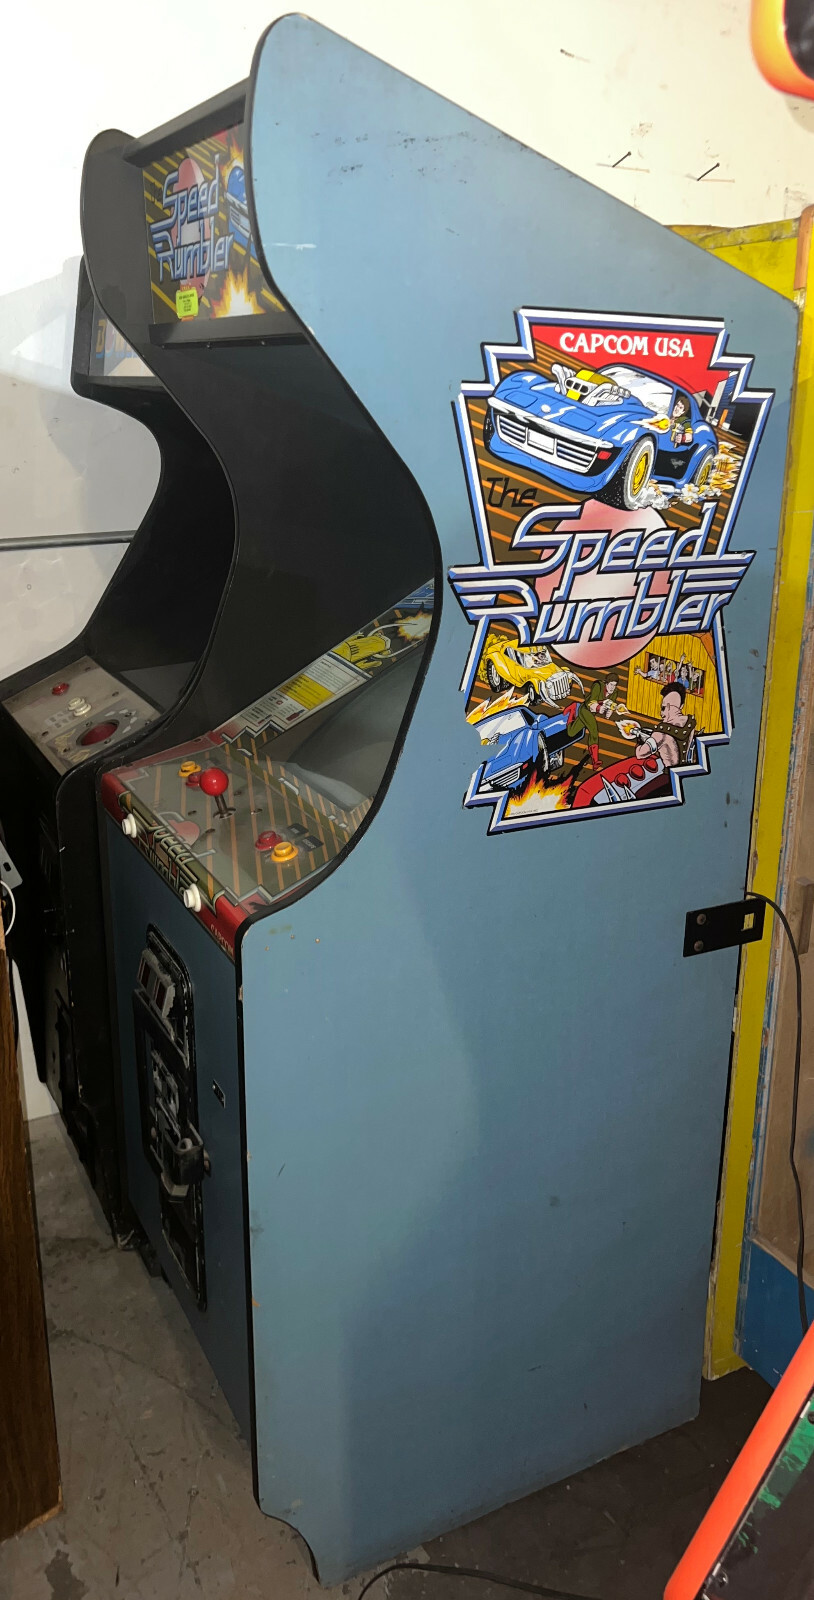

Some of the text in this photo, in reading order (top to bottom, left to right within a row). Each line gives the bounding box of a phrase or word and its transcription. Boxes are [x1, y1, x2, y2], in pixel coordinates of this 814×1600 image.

[150, 153, 219, 247] Speed
[152, 215, 234, 282] Rumbler
[559, 331, 695, 358] CAPCOM USA
[485, 476, 538, 510] The
[448, 501, 756, 601] Speed
[450, 568, 736, 645] Rumbler
